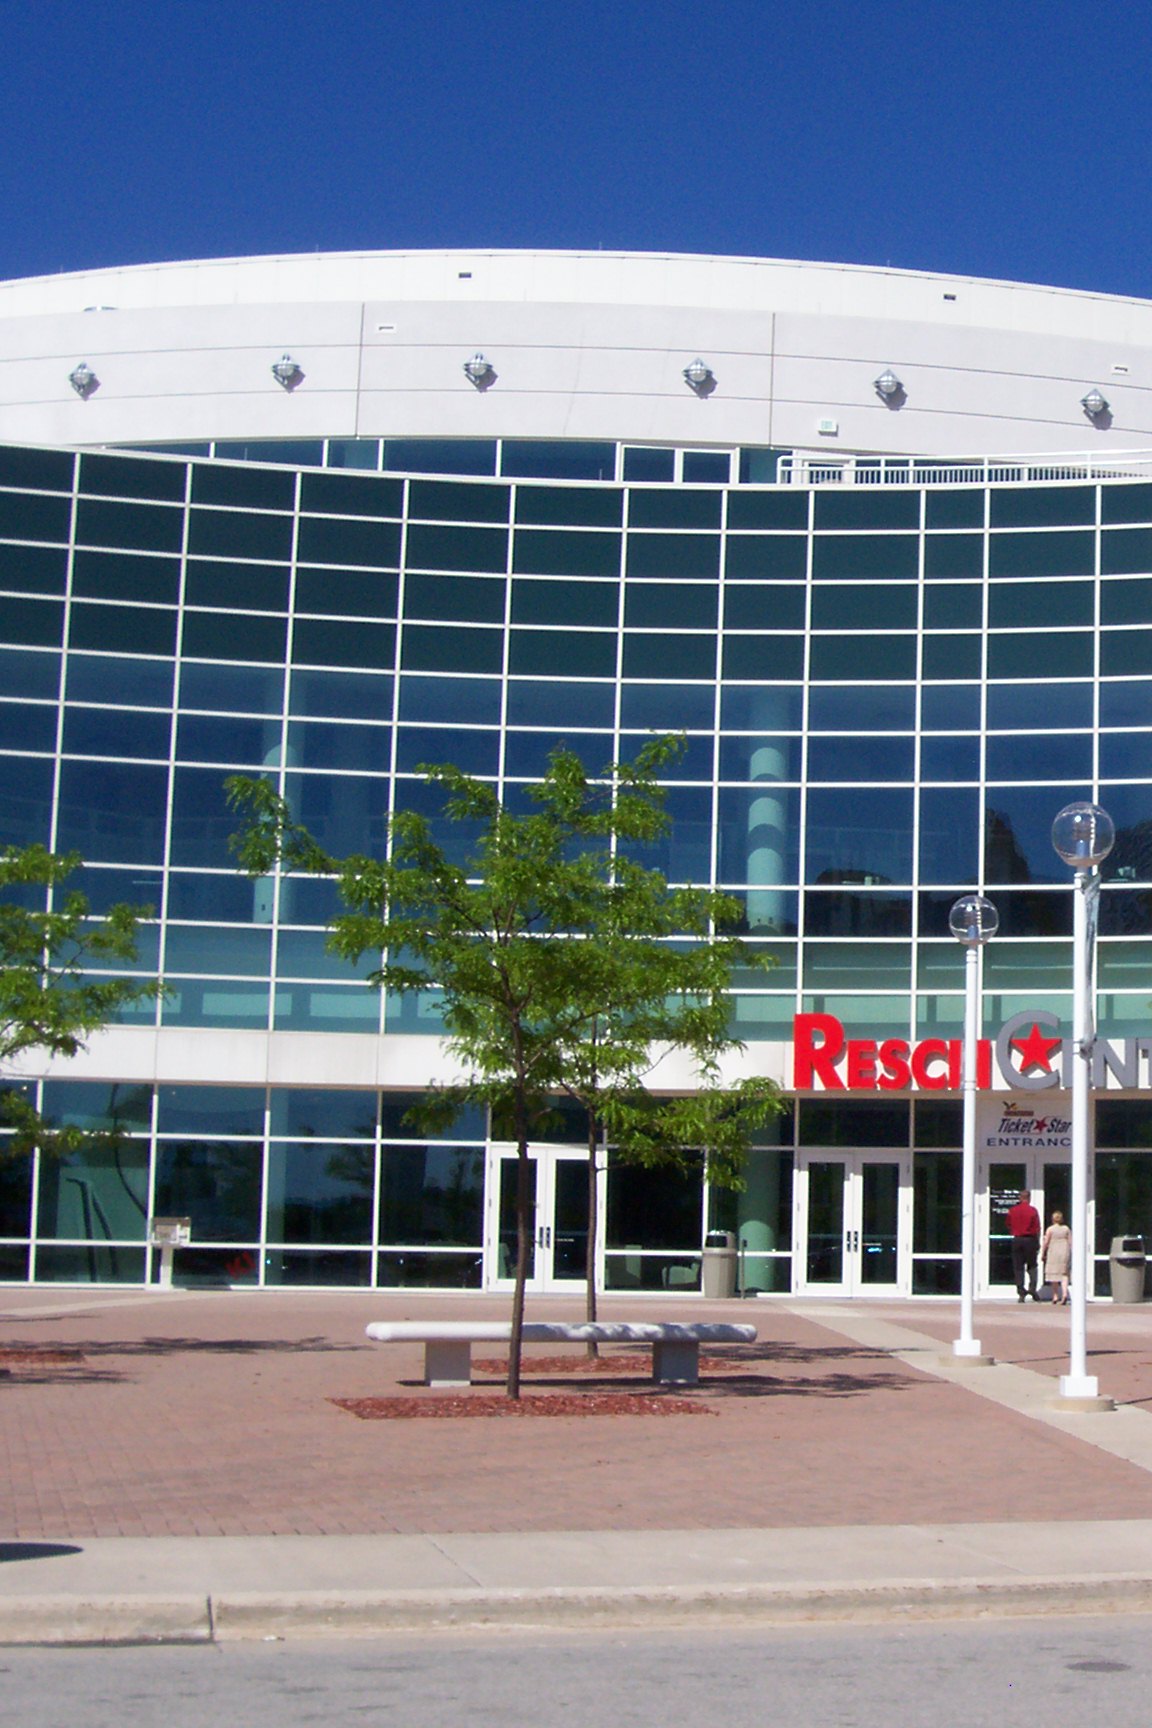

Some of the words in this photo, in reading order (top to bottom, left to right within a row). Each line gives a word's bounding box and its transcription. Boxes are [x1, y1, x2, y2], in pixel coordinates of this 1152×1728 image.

[998, 1117, 1035, 1134] Ticket
[1047, 1116, 1073, 1134] Star
[986, 1137, 1073, 1147] ENTRANC
